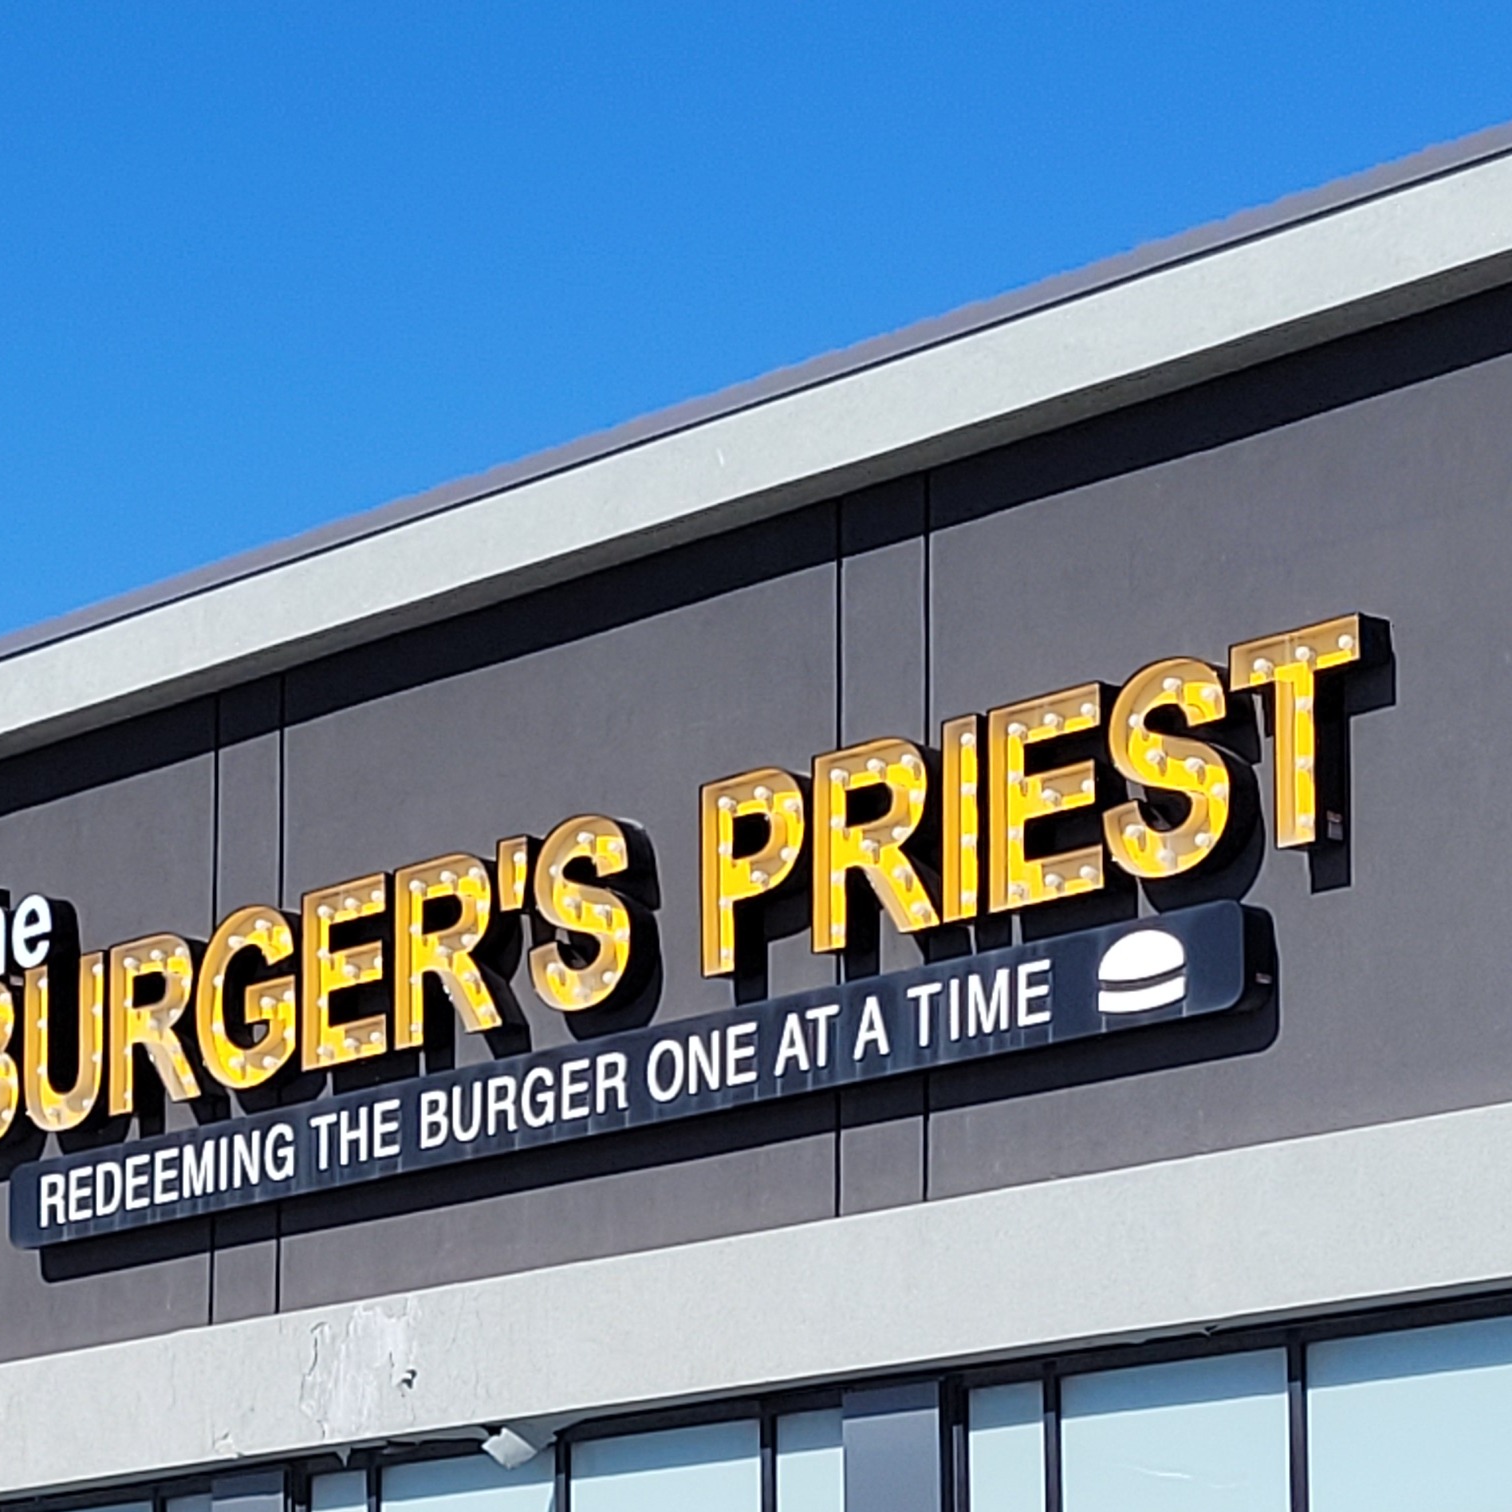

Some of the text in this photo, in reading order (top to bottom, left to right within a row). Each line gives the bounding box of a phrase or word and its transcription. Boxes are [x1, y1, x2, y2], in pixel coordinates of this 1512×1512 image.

[701, 612, 1360, 978] PRIEST
[39, 958, 1053, 1228] REDEEMING THE BURGER ONE AT A TIME
